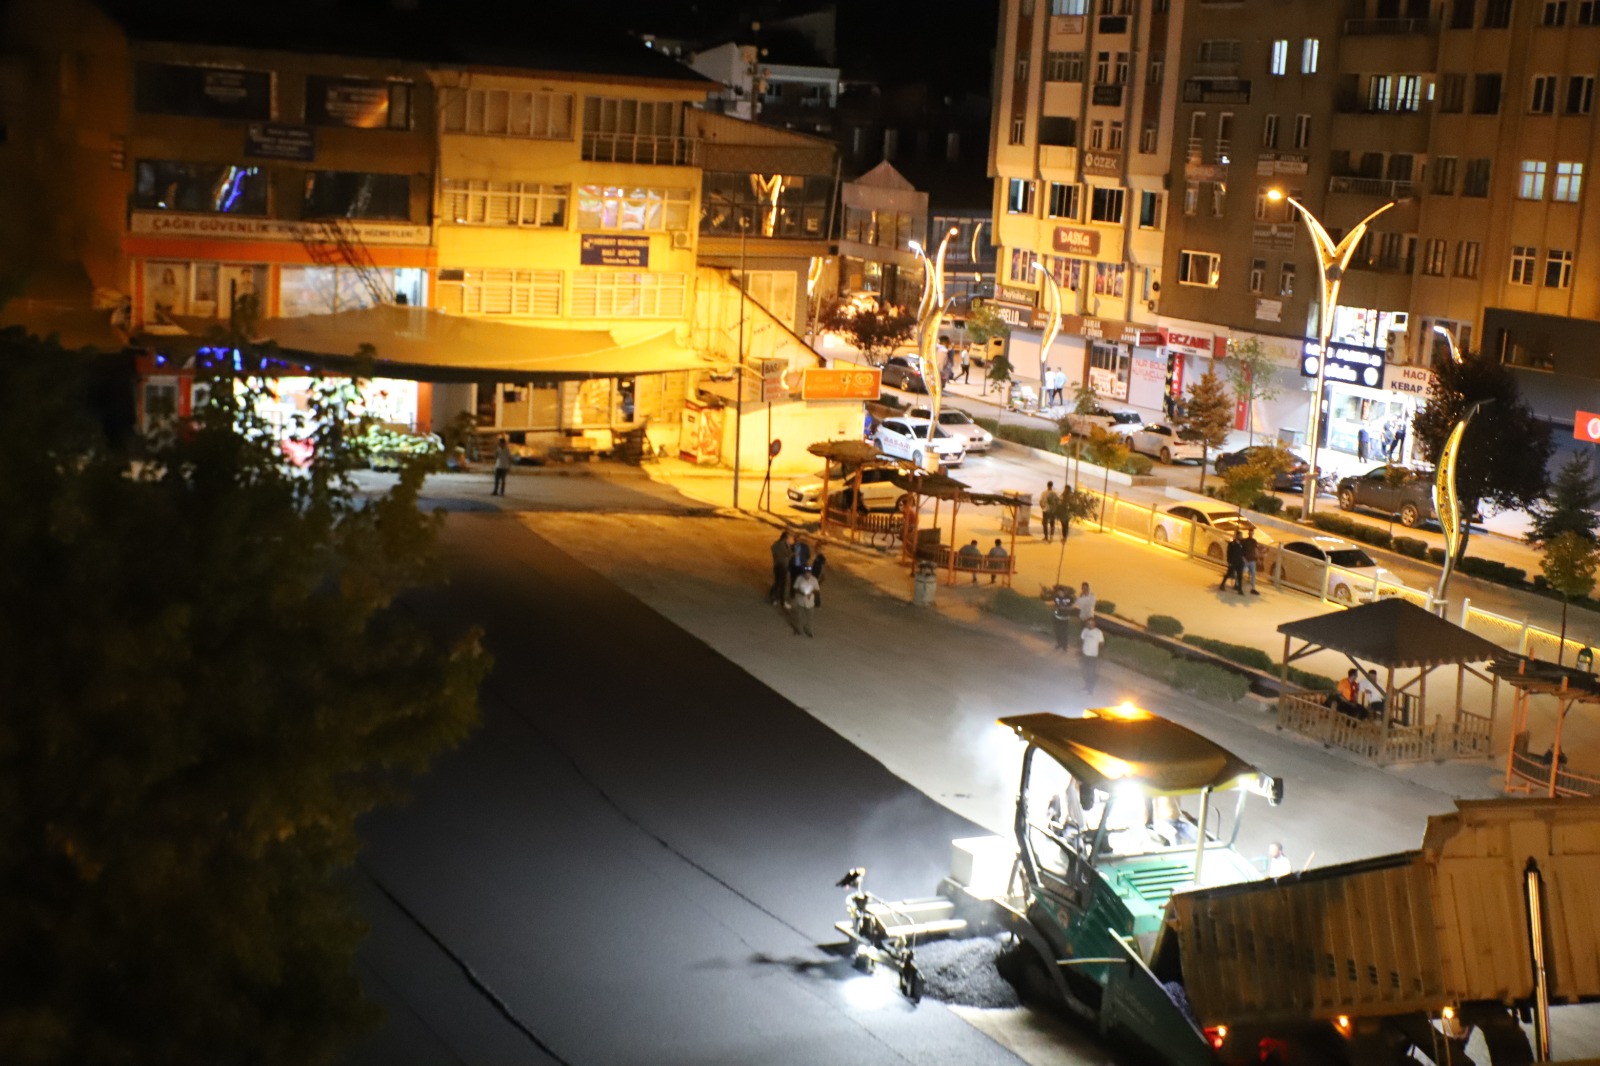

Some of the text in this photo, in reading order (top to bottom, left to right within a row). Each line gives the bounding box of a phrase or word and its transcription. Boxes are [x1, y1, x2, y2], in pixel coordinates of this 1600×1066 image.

[152, 216, 196, 229] ÇAĞRI
[199, 217, 269, 233] GÜVENLİK
[1168, 332, 1211, 351] ECZANE
[1403, 369, 1426, 380] HACI
[1391, 380, 1422, 394] KEBAP
